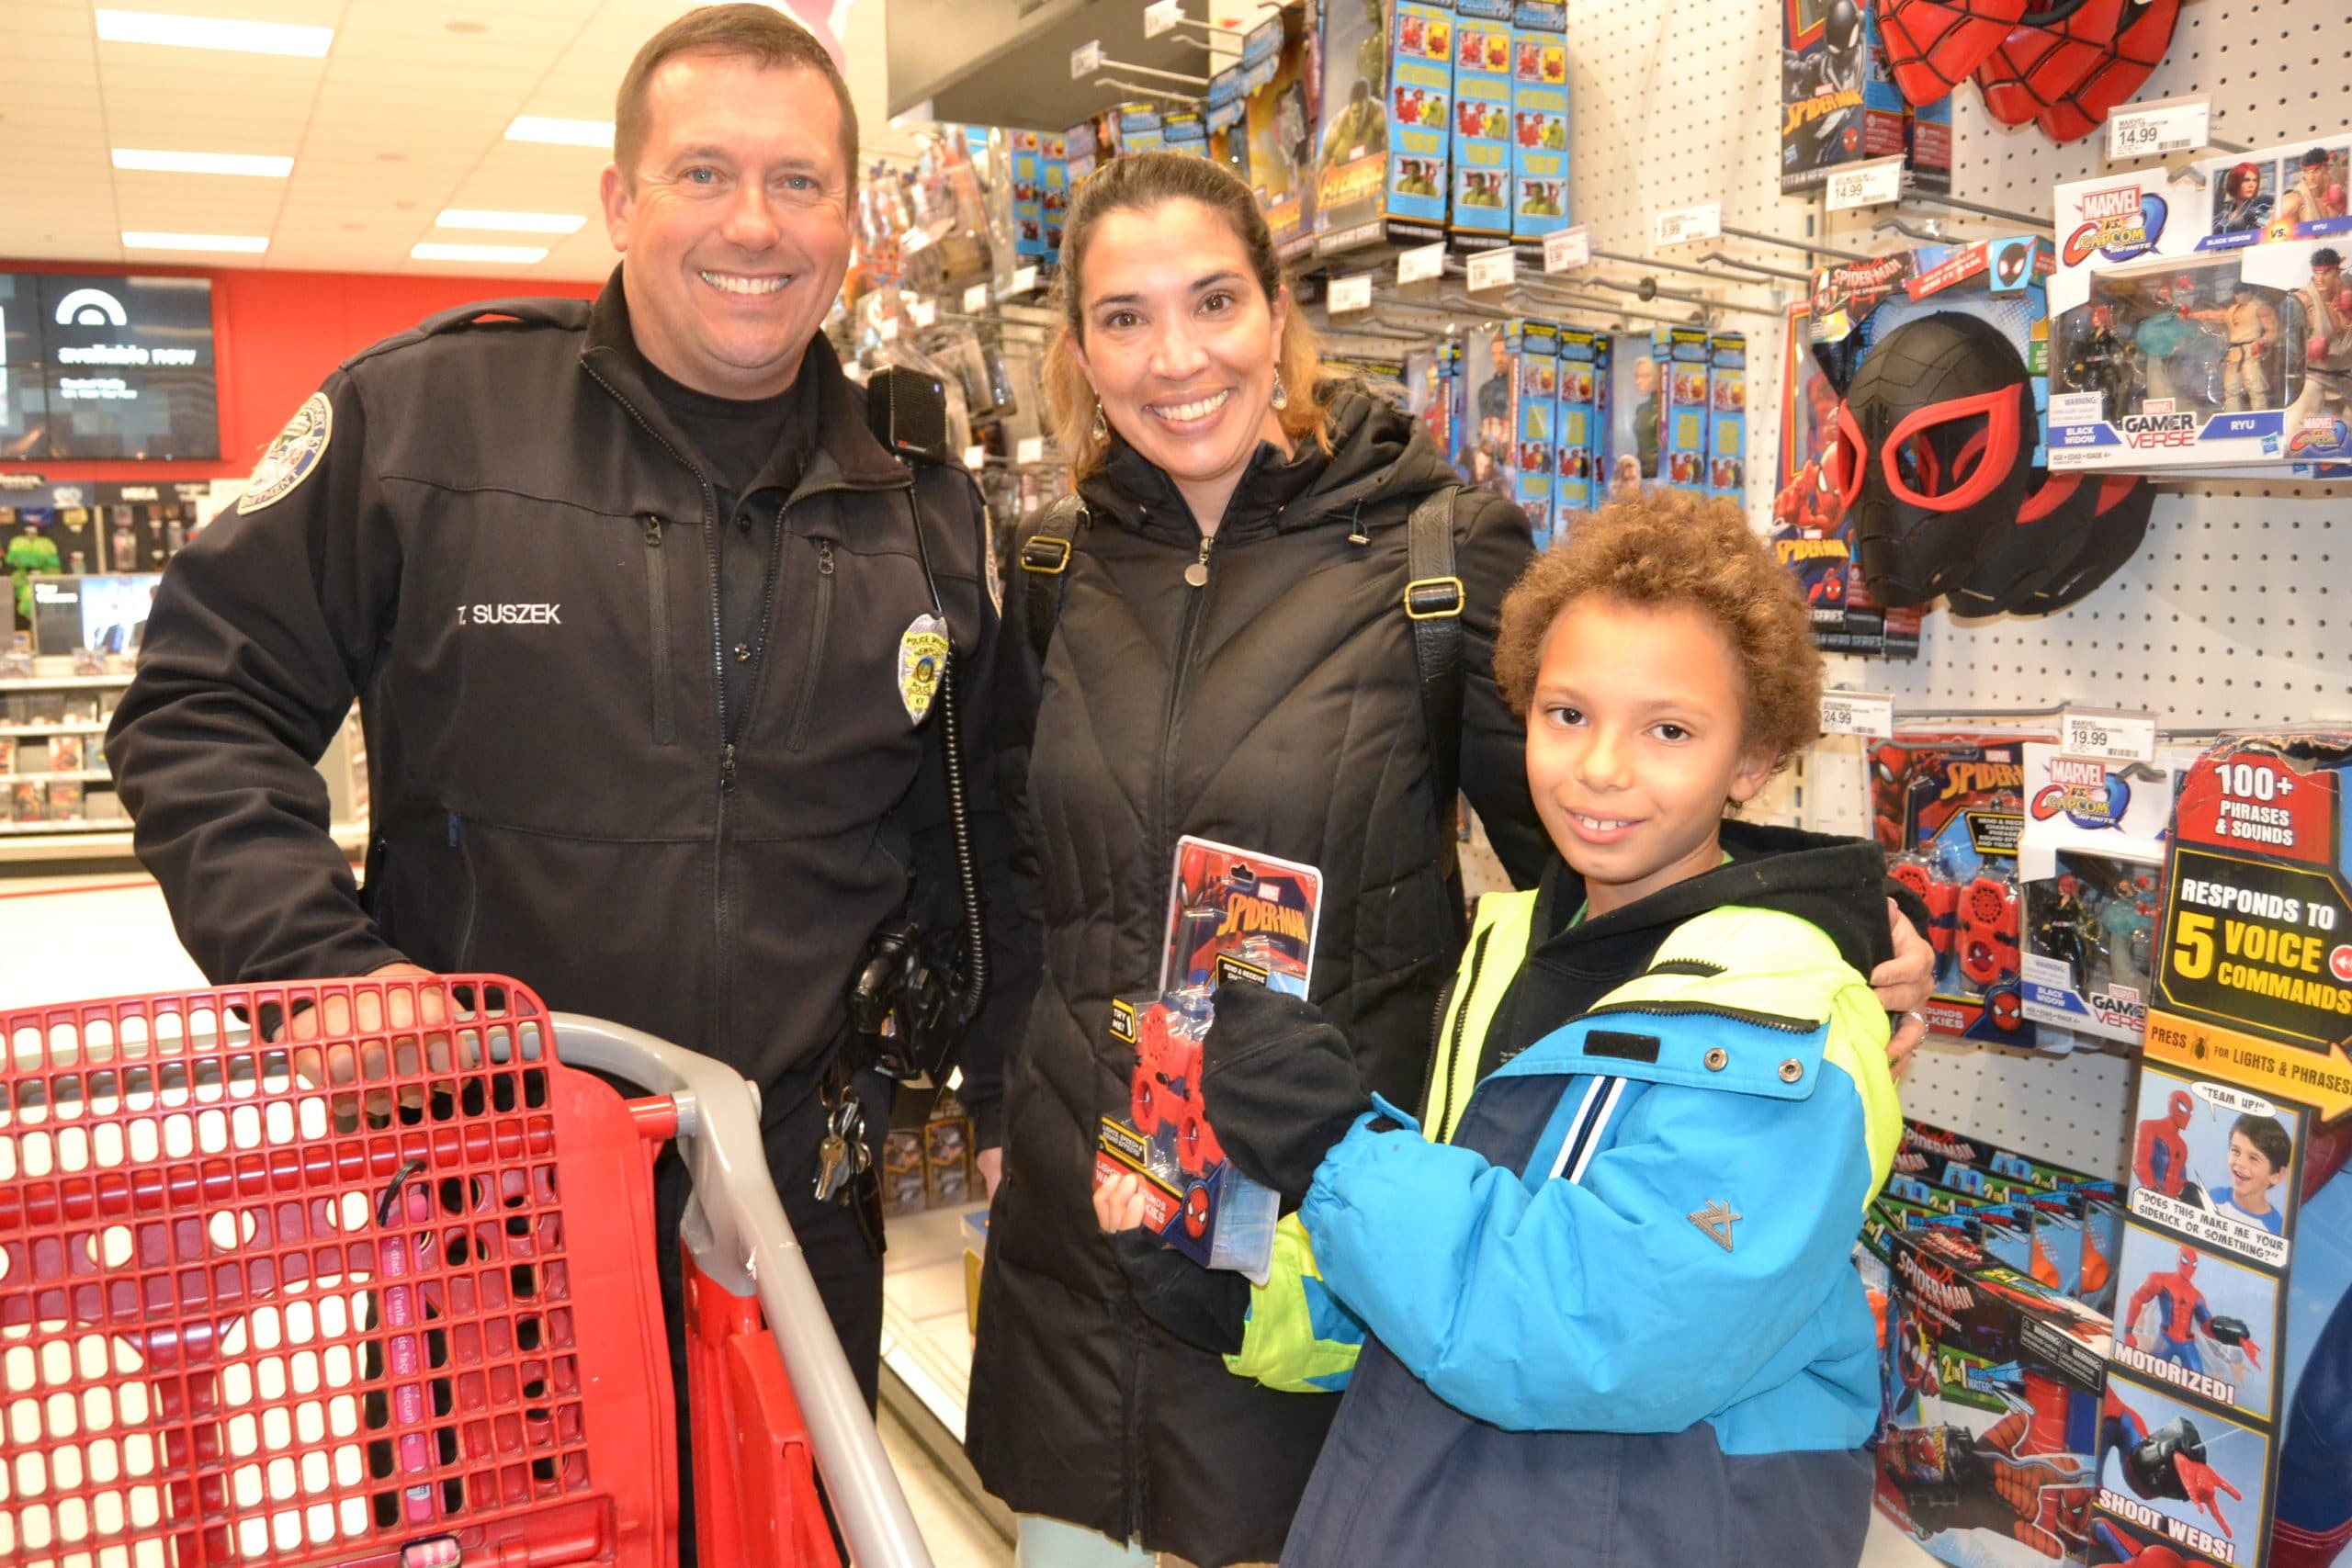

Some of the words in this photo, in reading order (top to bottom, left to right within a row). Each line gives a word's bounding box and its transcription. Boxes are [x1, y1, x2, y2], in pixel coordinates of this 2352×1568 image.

[1782, 88, 1864, 137] SPIDER-MAN
[2119, 127, 2158, 145] 14.99
[1836, 184, 1863, 198] 14.99
[2083, 187, 2139, 220] MARVEL
[2104, 218, 2121, 230] VS.
[2312, 222, 2327, 231] RYU
[2079, 227, 2146, 250] CAPCOM
[2207, 237, 2227, 246] BLACK
[2270, 228, 2287, 239] VS.
[1831, 258, 1903, 287] SPIDER-MAN
[152, 348, 197, 366] now
[2145, 401, 2172, 414] MARVEL
[2065, 426, 2095, 436] BLACK
[2125, 414, 2195, 433] GAMER
[2230, 420, 2256, 431] RYU
[2064, 435, 2096, 446] WIDOW
[2126, 431, 2196, 449] VERSE
[472, 604, 562, 625] SUSZEK
[906, 636, 929, 647] POLICE
[1824, 710, 1852, 724] 24.99
[2072, 730, 2108, 746] 19.99
[2052, 761, 2105, 787] MARVEL
[2214, 763, 2293, 802] 100+
[2071, 787, 2087, 797] VS.
[2047, 795, 2110, 816] CAPCOM
[2220, 800, 2290, 827] PHRASES
[2215, 818, 2227, 836] &
[2232, 820, 2294, 846] SOUNDS
[2180, 878, 2301, 924] RESPONDS
[2307, 902, 2335, 931] TO
[1216, 893, 1308, 944] SPIDER-MAN
[2174, 910, 2215, 980] 5
[2225, 919, 2324, 974] VOICE
[2035, 993, 2066, 1008] WIDOW
[2037, 986, 2064, 999] BLACK
[1113, 1008, 1127, 1021] TRY
[1926, 1007, 1963, 1020] OUNDS
[1926, 1014, 1964, 1030] LKIES
[2095, 1009, 2146, 1033] VERS
[1112, 1020, 1125, 1033] ME!
[2151, 1026, 2188, 1049] PRESS
[2214, 1046, 2230, 1059] FOR
[2233, 1048, 2276, 1074] LIGHTS
[2278, 1062, 2288, 1077] &
[1905, 1126, 1976, 1162] PIDER-MAN
[1145, 1204, 1166, 1224] KIES
[2139, 1203, 2181, 1228] SIDEKICK
[2185, 1223, 2199, 1235] OR
[2174, 1203, 2195, 1220] THIS
[2200, 1214, 2228, 1232] MAKE
[2234, 1225, 2250, 1239] ME
[2256, 1234, 2284, 1251] YOUR
[1897, 1249, 1975, 1310] SPIDER-MAN
[398, 1336, 408, 1350] de
[2114, 1339, 2235, 1405] MOTORIZED!
[2098, 1488, 2162, 1528] SHOOT
[2167, 1515, 2235, 1563] WEBS!
